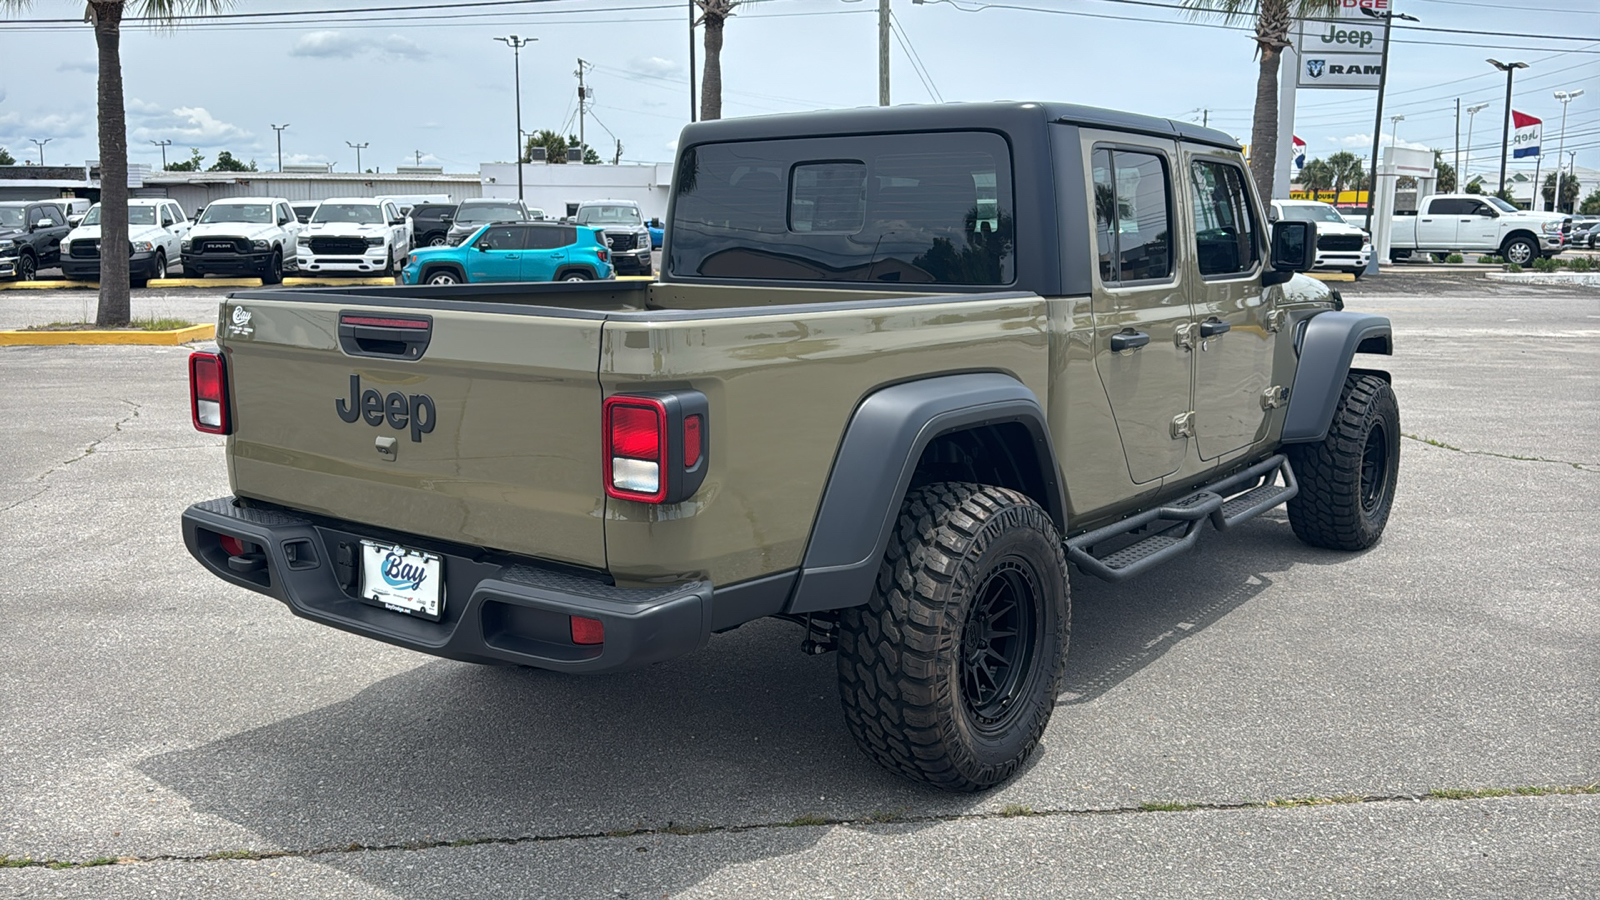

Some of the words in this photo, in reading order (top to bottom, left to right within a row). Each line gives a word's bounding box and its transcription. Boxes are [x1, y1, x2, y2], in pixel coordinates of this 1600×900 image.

[1321, 25, 1373, 48] Jeep
[1329, 65, 1382, 75] RAM
[233, 305, 252, 325] Bay
[335, 373, 437, 443] Jeep
[385, 552, 427, 591] Bay
